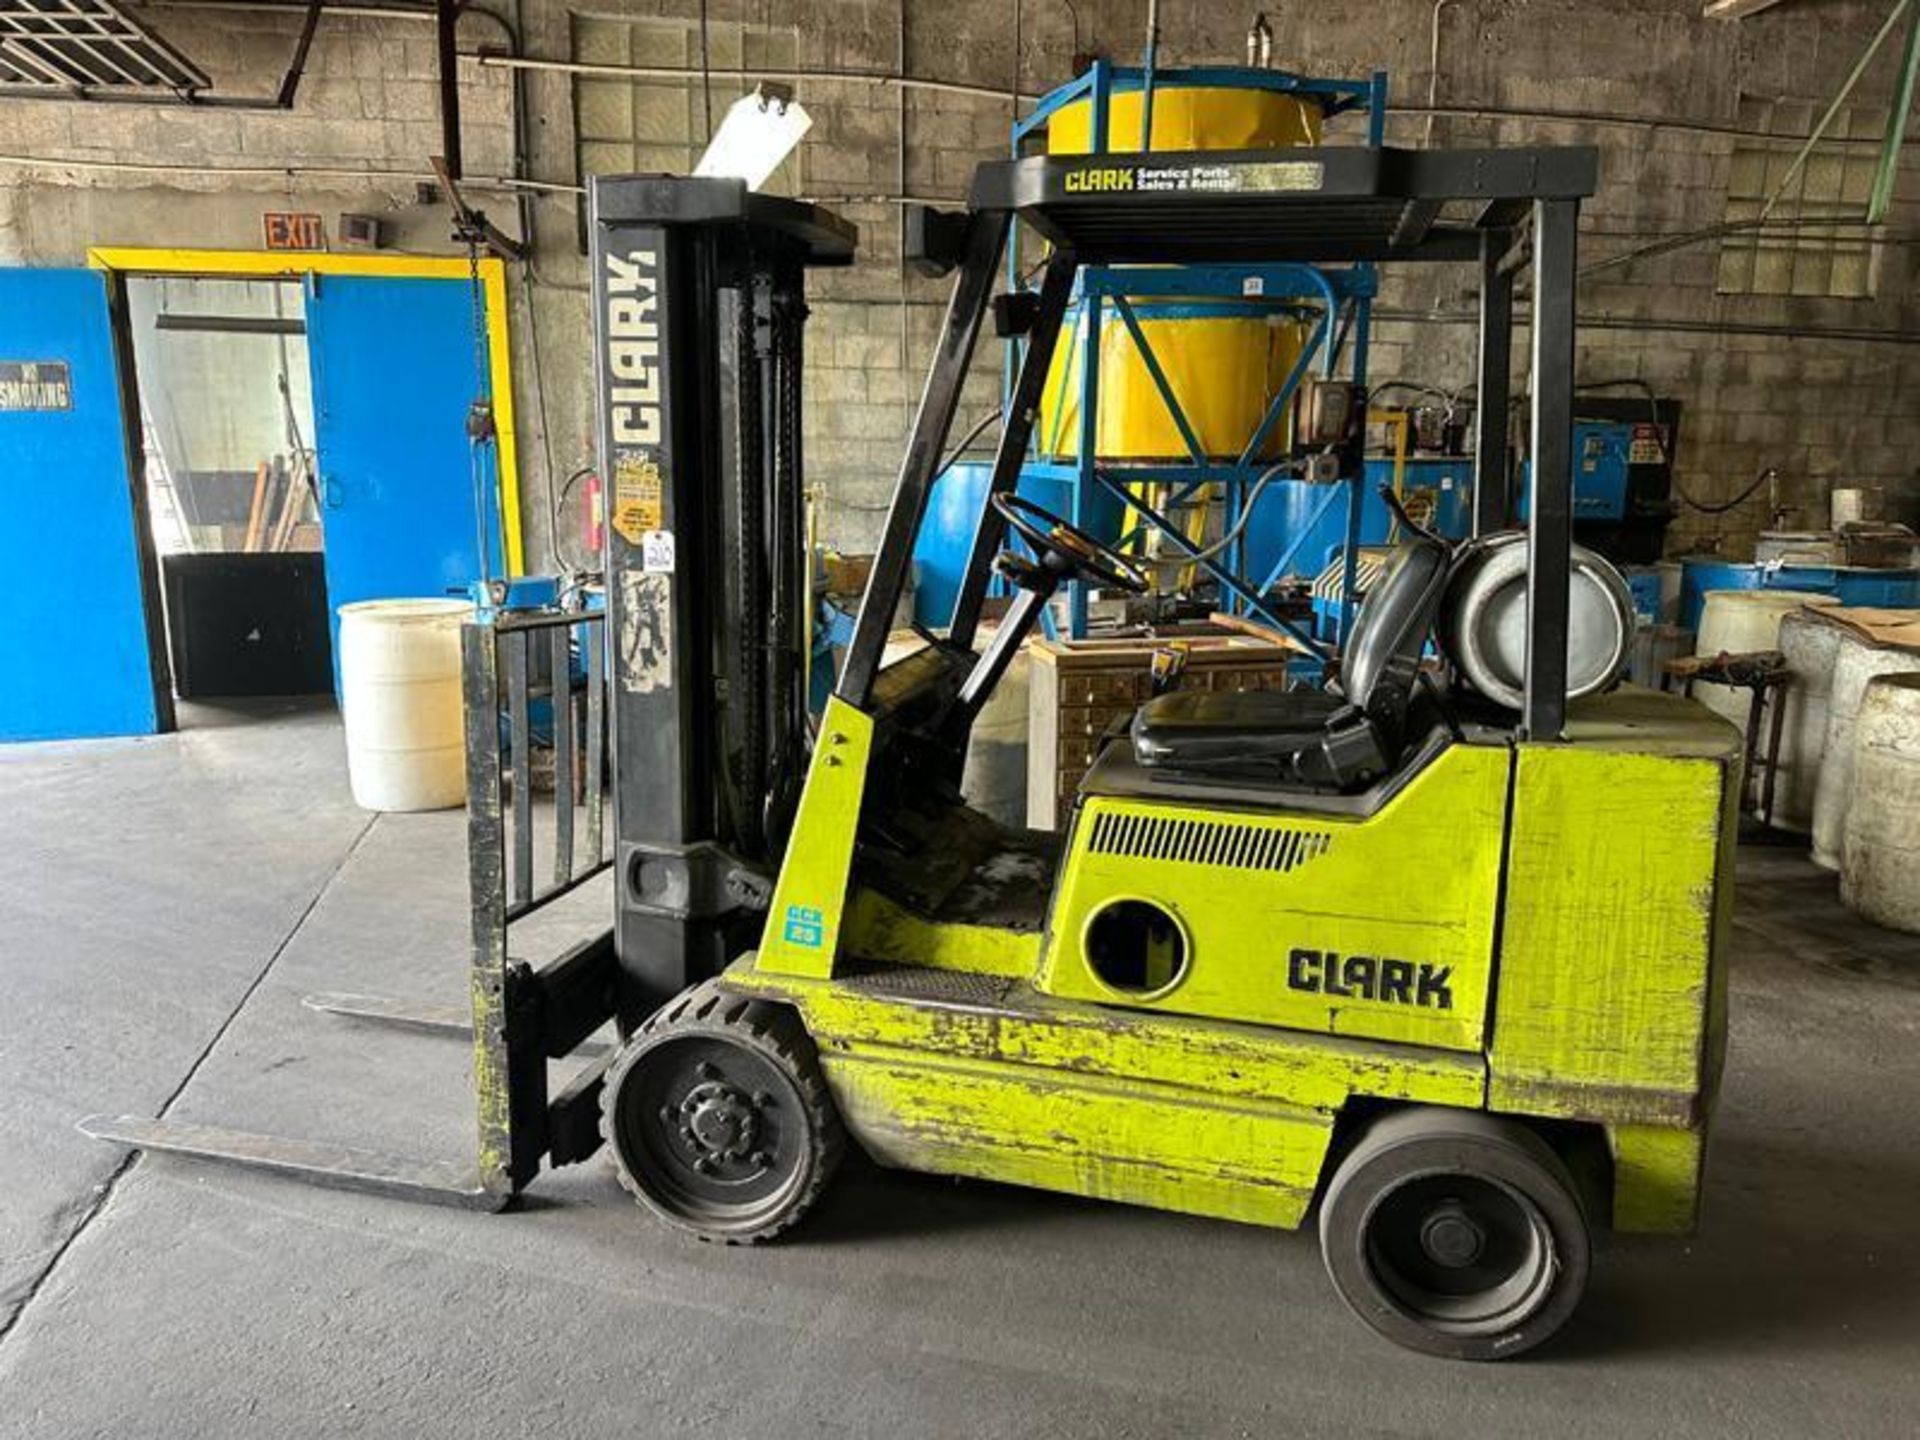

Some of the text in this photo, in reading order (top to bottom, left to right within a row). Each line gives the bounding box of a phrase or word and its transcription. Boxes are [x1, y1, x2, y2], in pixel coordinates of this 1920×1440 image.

[1065, 168, 1134, 191] CLARK
[1137, 167, 1230, 179] Service Parts
[1137, 179, 1174, 190] Sales
[267, 215, 321, 248] EXIT
[607, 251, 662, 443] CLARK
[1288, 948, 1455, 1010] CLARK
